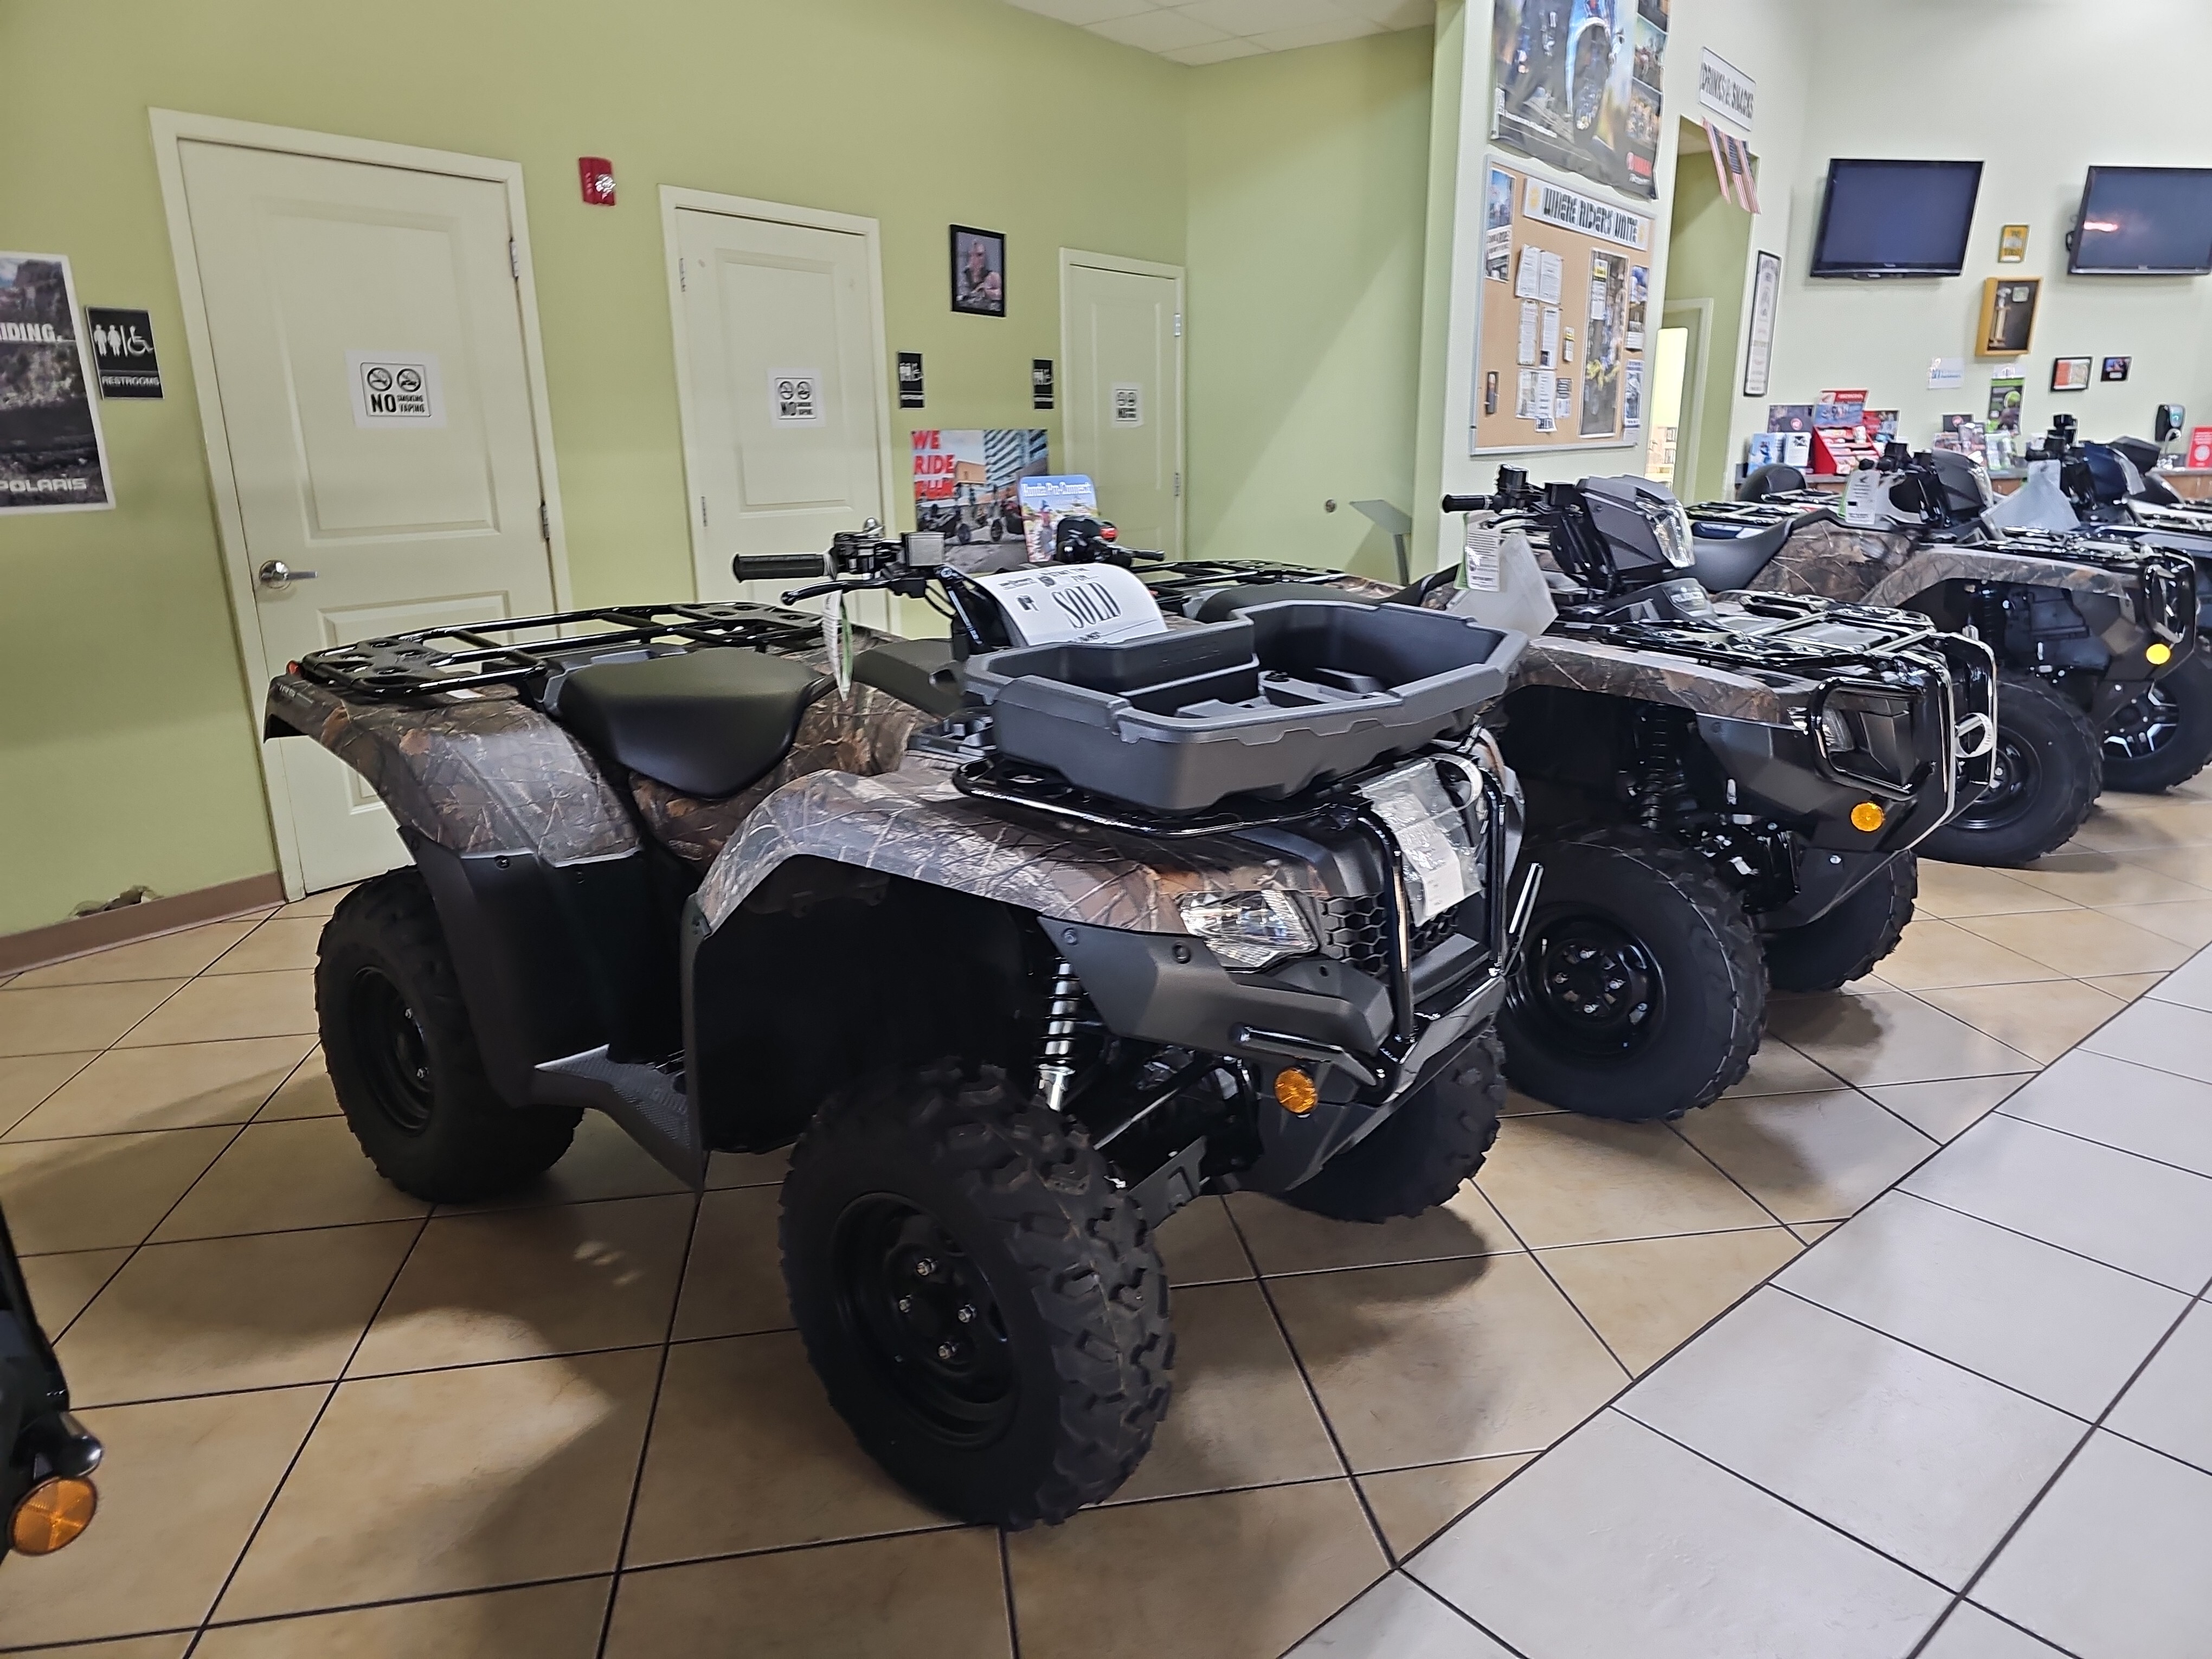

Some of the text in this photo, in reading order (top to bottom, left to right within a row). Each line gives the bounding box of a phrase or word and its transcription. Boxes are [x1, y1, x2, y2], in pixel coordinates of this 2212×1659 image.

[1700, 62, 1726, 103] DRINKS
[1731, 82, 1754, 119] SNACKS
[101, 376, 160, 386] RESTROOMS
[370, 393, 396, 413] NO
[912, 430, 940, 449] WE
[914, 454, 955, 474] RIDE
[1051, 582, 1121, 629] SOLD
